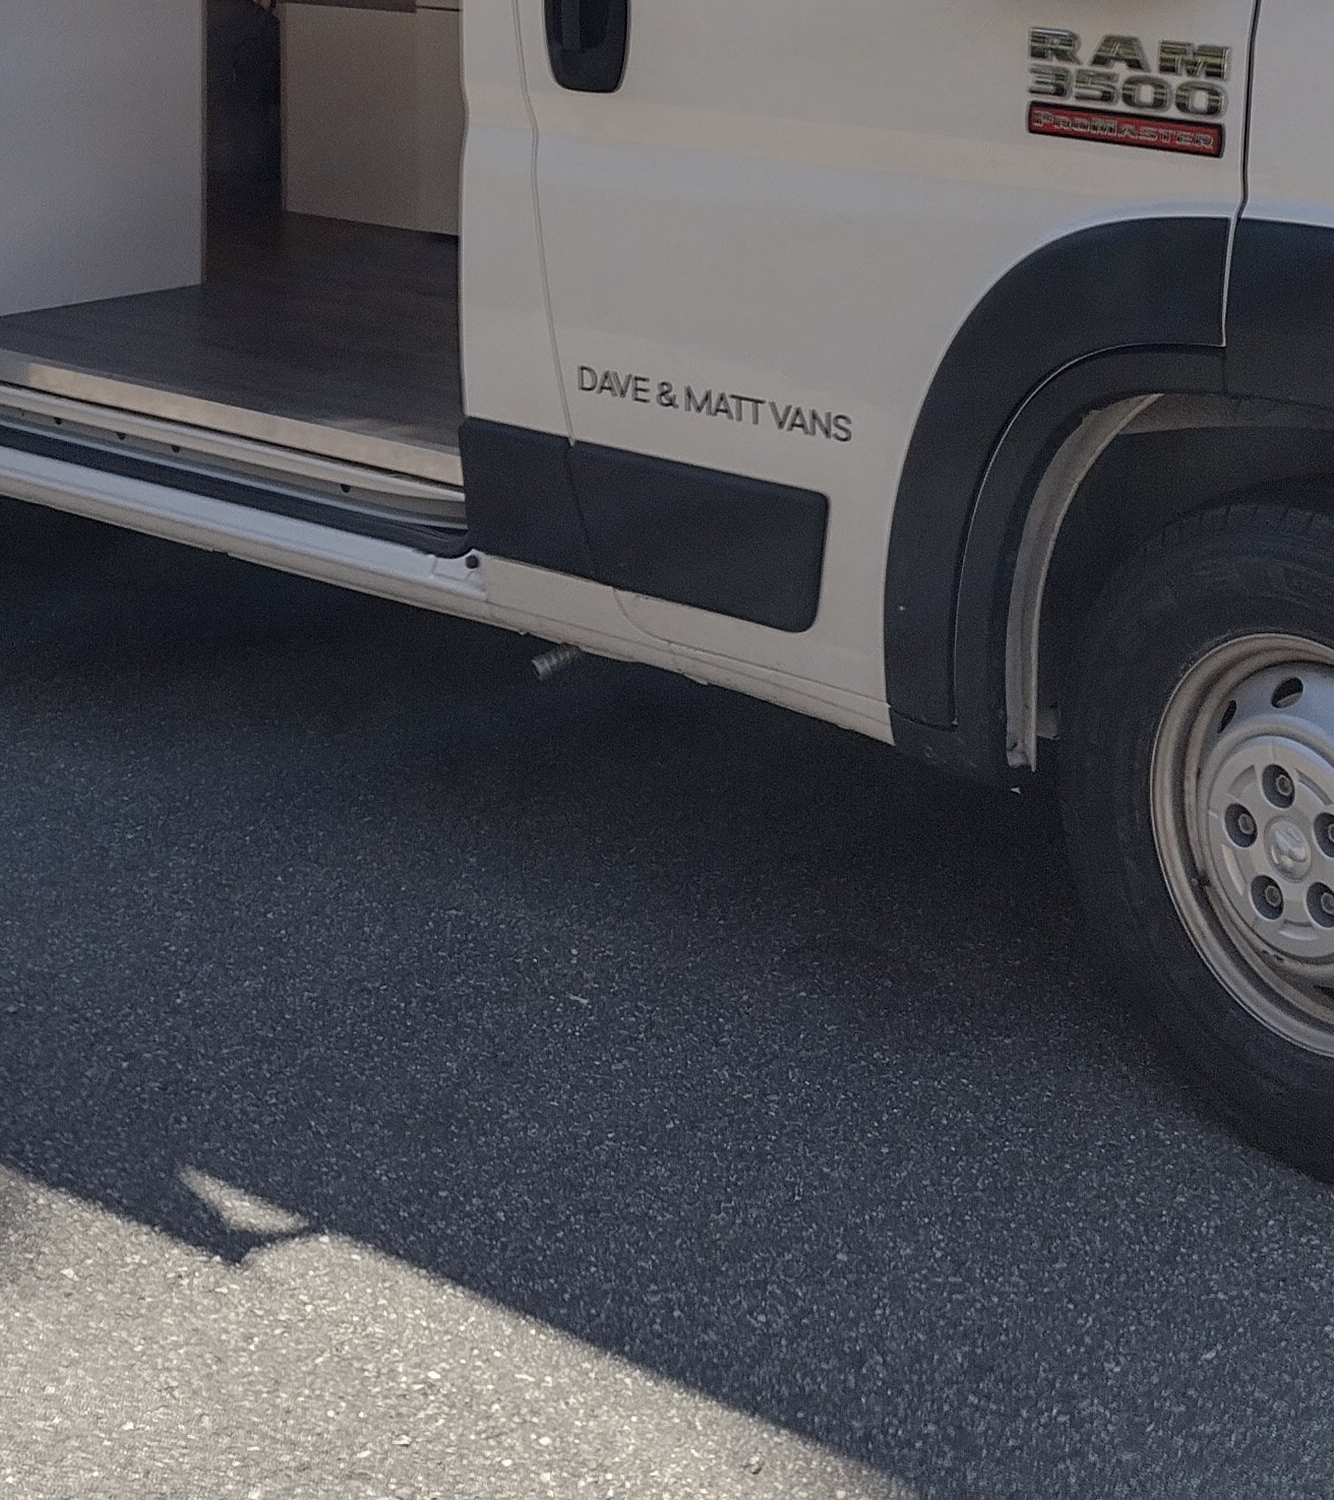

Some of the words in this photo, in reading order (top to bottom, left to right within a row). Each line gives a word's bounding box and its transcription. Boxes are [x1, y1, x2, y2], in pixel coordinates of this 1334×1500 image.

[1028, 26, 1231, 81] RAM
[1027, 63, 1227, 118] 3500
[577, 365, 650, 402] DAVE
[657, 381, 679, 408] &
[684, 386, 765, 425] MATT
[768, 401, 853, 442] VANS
